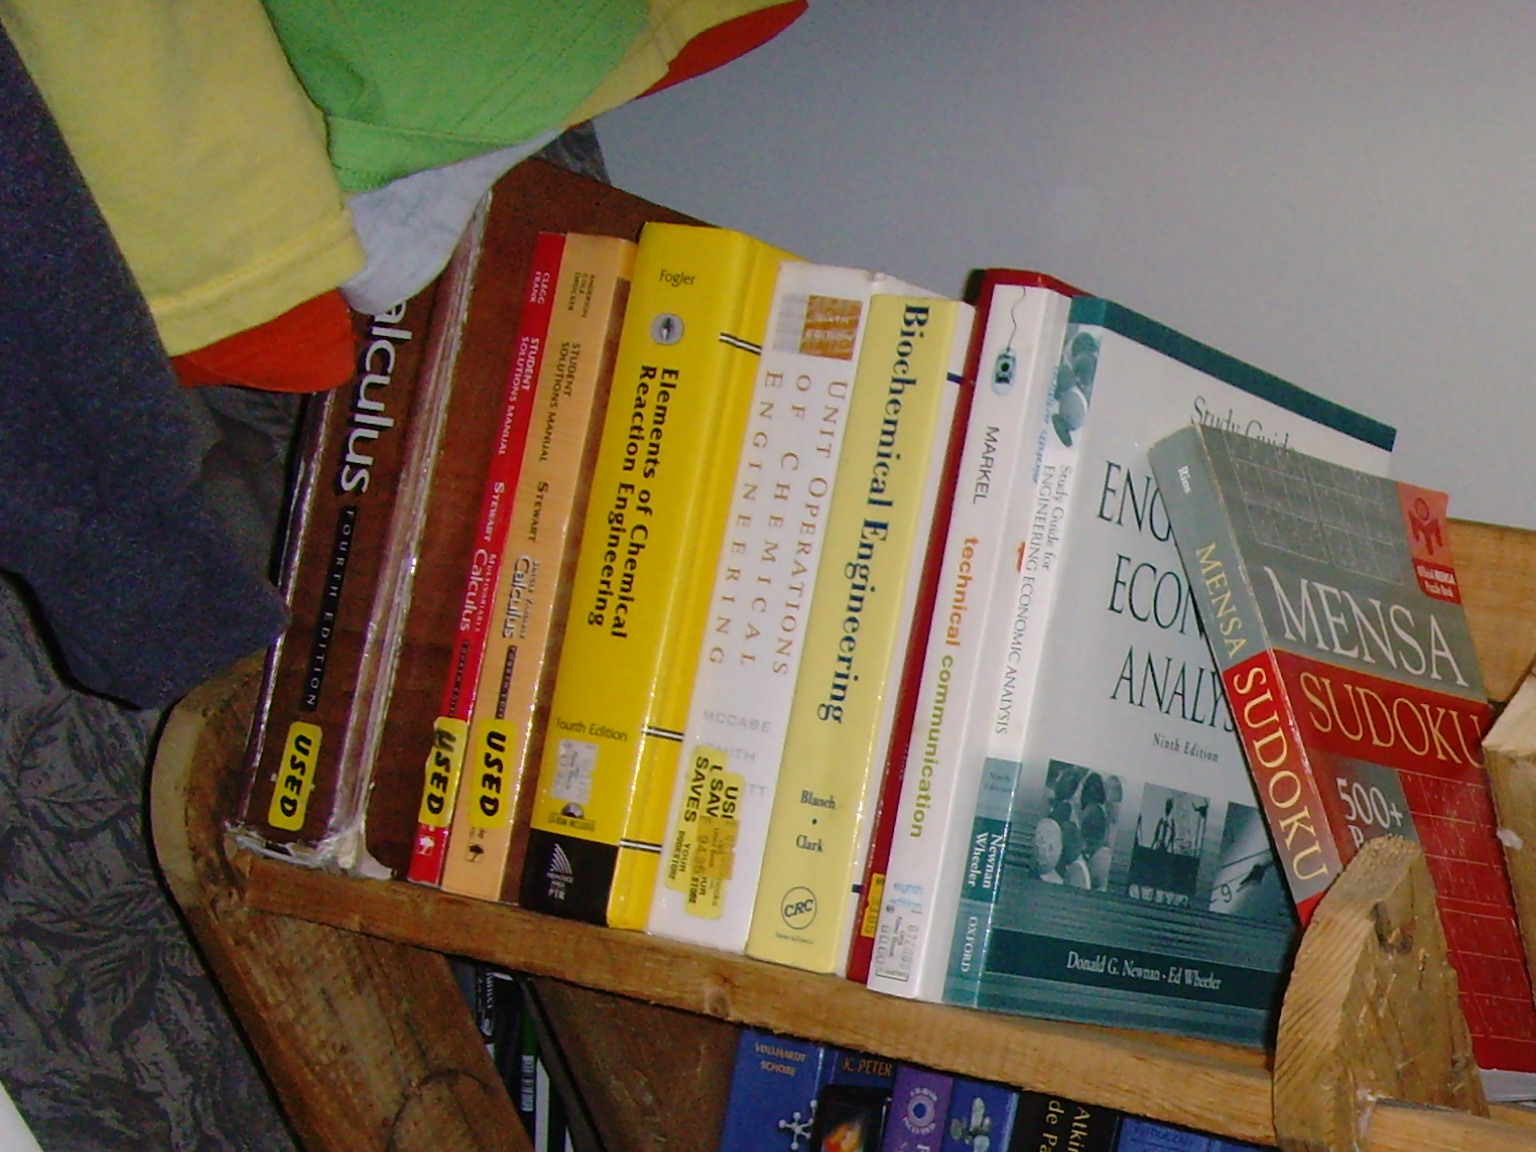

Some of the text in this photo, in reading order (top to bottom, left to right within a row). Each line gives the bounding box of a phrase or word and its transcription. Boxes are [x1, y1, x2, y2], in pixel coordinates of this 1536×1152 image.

[659, 269, 696, 287] Fogler
[499, 336, 530, 455] SOLUTIONS MANUAL
[521, 337, 540, 391] STUDENT
[541, 342, 571, 462] SOLUTIONS MANUAL
[567, 343, 581, 398] STUDENT
[587, 365, 657, 627] Reaction Engineering
[611, 367, 679, 638] Elements of Chemical
[973, 426, 1000, 504] MARKEL
[1178, 465, 1192, 494] Rios
[484, 482, 505, 542] STEWART
[529, 482, 549, 542] STEWART
[708, 371, 783, 664] ENGINEERING
[740, 374, 812, 664] OF CHEMICAL
[772, 380, 848, 676] UNIT OPERATIONS
[817, 304, 930, 724] Biochemical Engineering
[1023, 465, 1055, 571] ENGINEERING
[309, 510, 354, 706] FOURTH EDITION
[459, 548, 489, 632] Calculus
[1007, 577, 1035, 674] ECONOMIC
[1195, 541, 1247, 659] MENSA
[1264, 566, 1470, 687] MENSA
[555, 717, 627, 741] Fourth Edition
[910, 537, 979, 839] technical communication
[995, 676, 1019, 735] ANALYSIS
[1300, 671, 1487, 769] SUDOKU
[280, 734, 313, 818] USED
[481, 731, 507, 817] USED
[683, 755, 710, 822] SAVES
[1153, 734, 1219, 762] Ninth Edition
[1233, 667, 1329, 881] SUDOKU
[801, 790, 835, 809] Blanch
[796, 835, 823, 852] Clark
[968, 832, 989, 887] Wheeler
[982, 834, 1004, 888] Newnan
[961, 916, 979, 972] OXFORD
[1066, 951, 1222, 991] Donald G. Newnan Ed Wheeler
[1046, 1099, 1065, 1126] de
